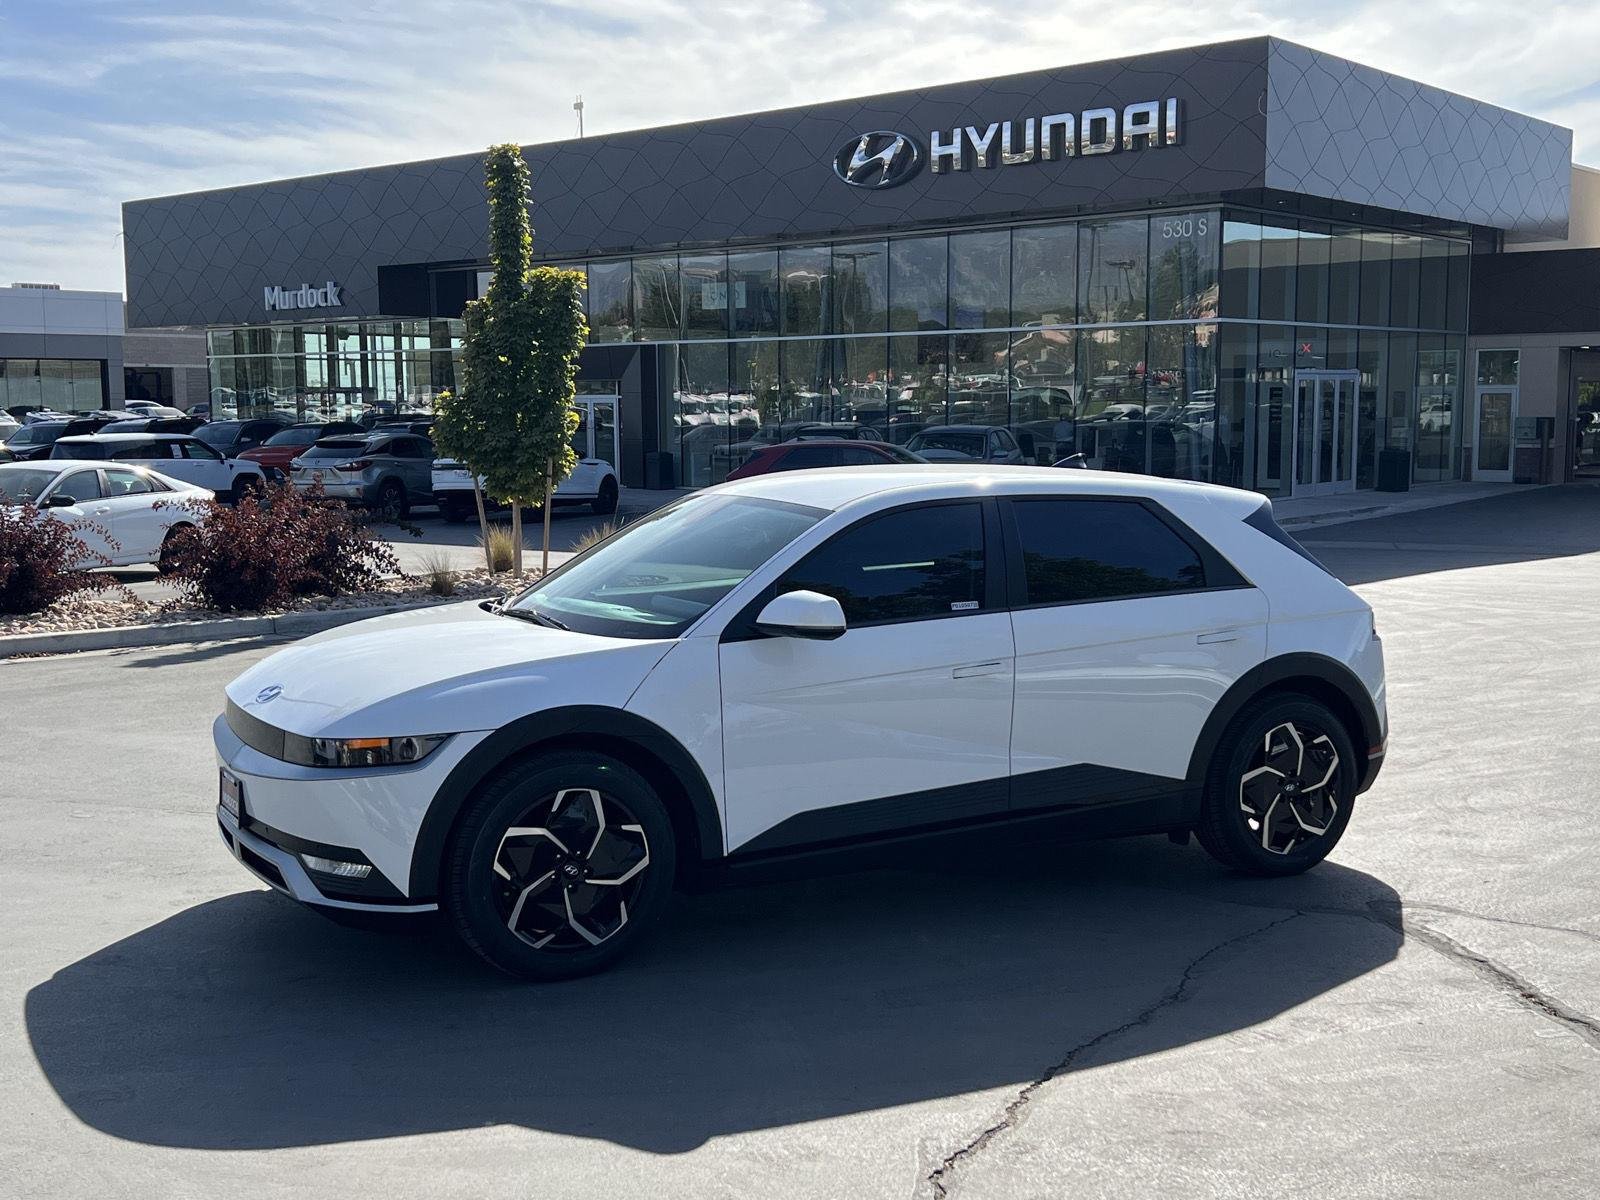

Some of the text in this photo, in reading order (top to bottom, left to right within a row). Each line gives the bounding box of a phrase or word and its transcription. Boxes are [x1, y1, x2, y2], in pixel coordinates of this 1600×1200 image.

[930, 97, 1179, 174] HYUNDAI
[1162, 217, 1208, 239] 530 S
[263, 281, 342, 311] Murdock
